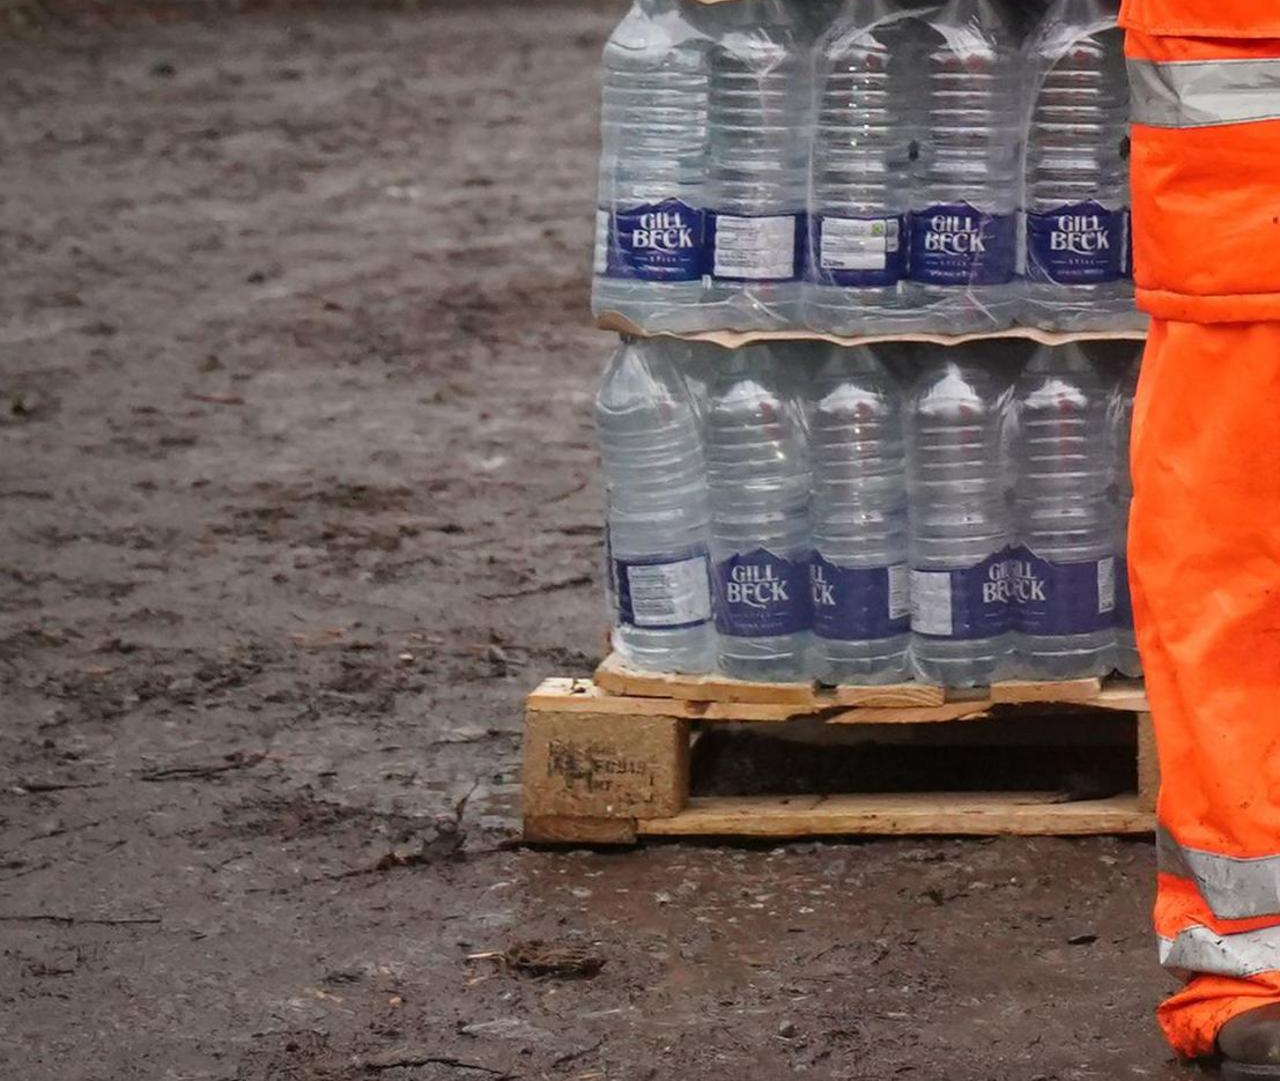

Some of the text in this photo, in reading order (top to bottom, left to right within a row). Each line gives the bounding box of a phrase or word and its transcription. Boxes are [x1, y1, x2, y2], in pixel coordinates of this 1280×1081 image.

[640, 212, 688, 230] GILL
[931, 215, 979, 232] GILL
[1058, 215, 1104, 232] GILL
[632, 228, 694, 254] BECK
[924, 231, 986, 256] BECK
[1050, 230, 1110, 256] BECK
[731, 564, 779, 582] GILL
[727, 580, 789, 609] BECK
